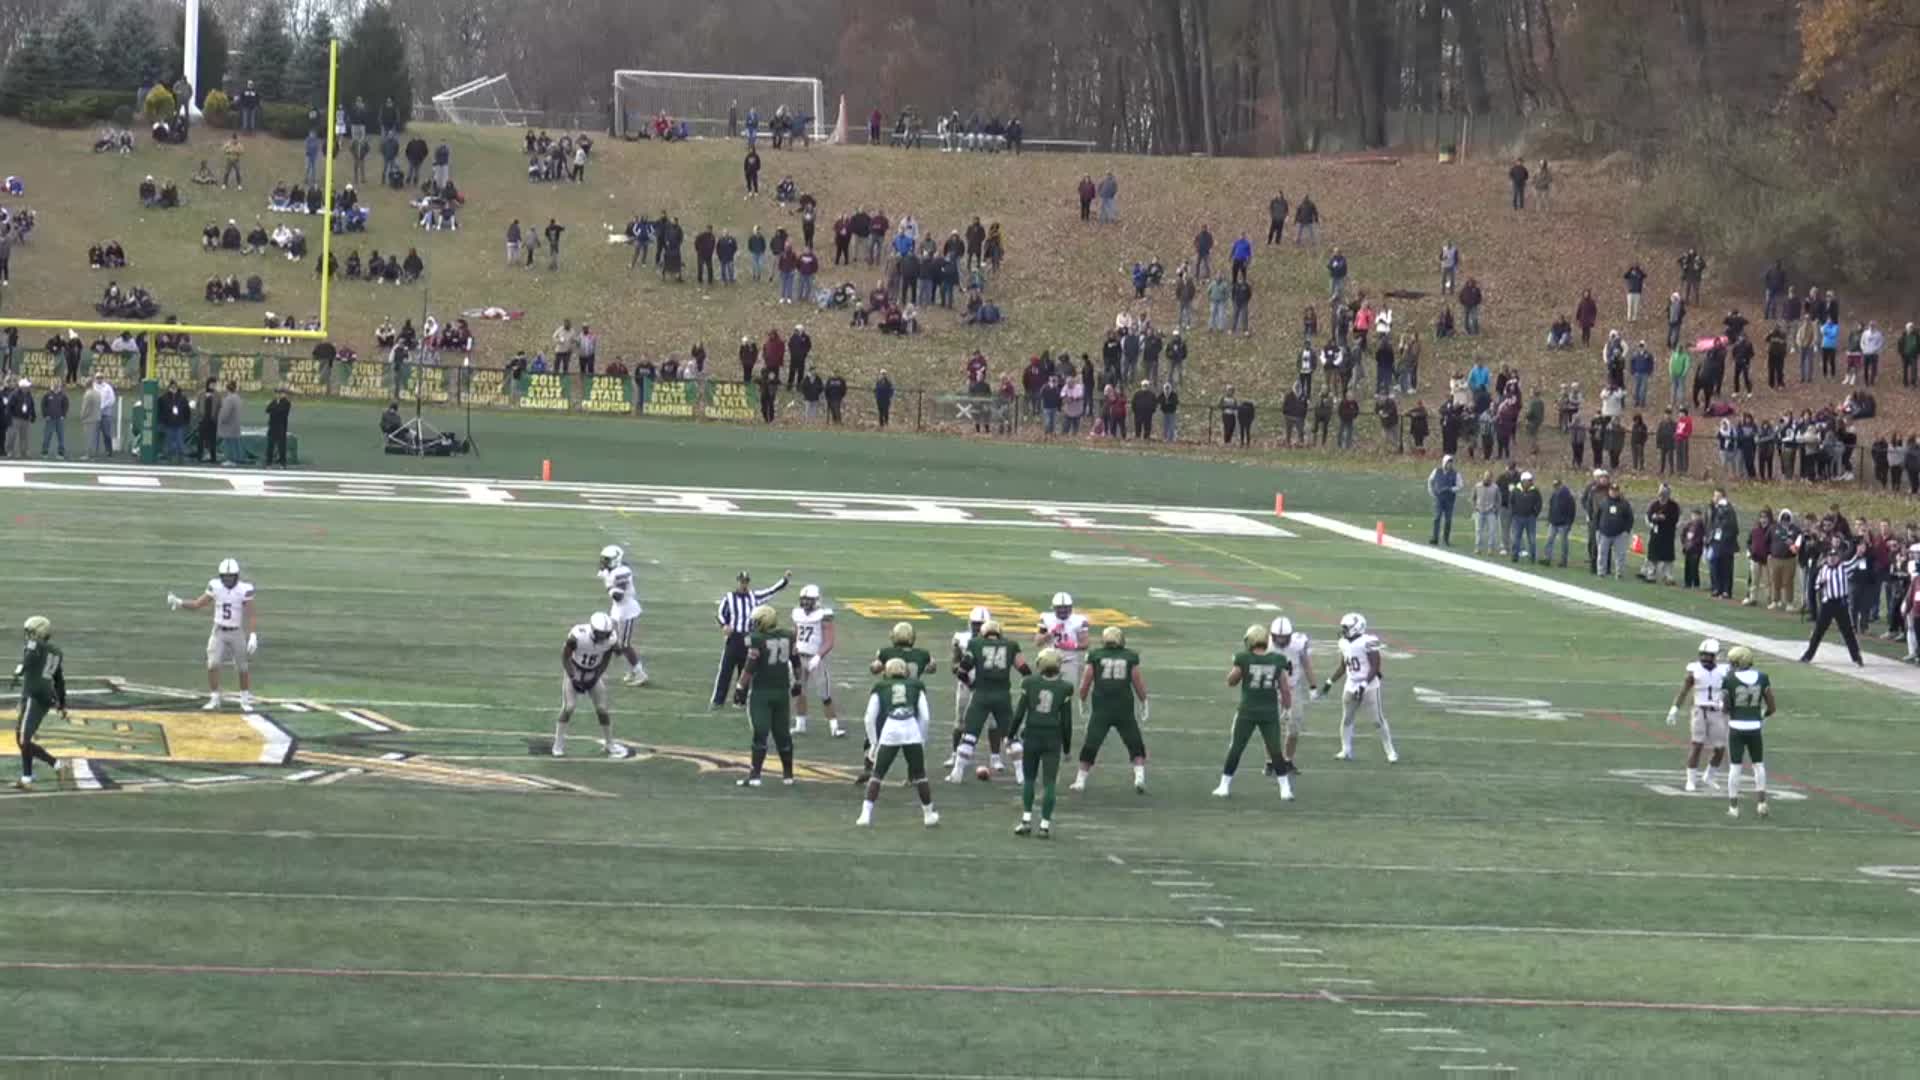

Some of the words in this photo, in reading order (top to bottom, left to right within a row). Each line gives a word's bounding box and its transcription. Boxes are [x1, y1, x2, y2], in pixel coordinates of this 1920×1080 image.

[531, 374, 560, 386] 2011
[528, 386, 562, 398] STATE
[590, 388, 625, 401] STATE
[651, 391, 687, 404] STATE
[712, 395, 749, 408] STATE
[222, 602, 232, 620] 5
[982, 646, 1007, 669] 74
